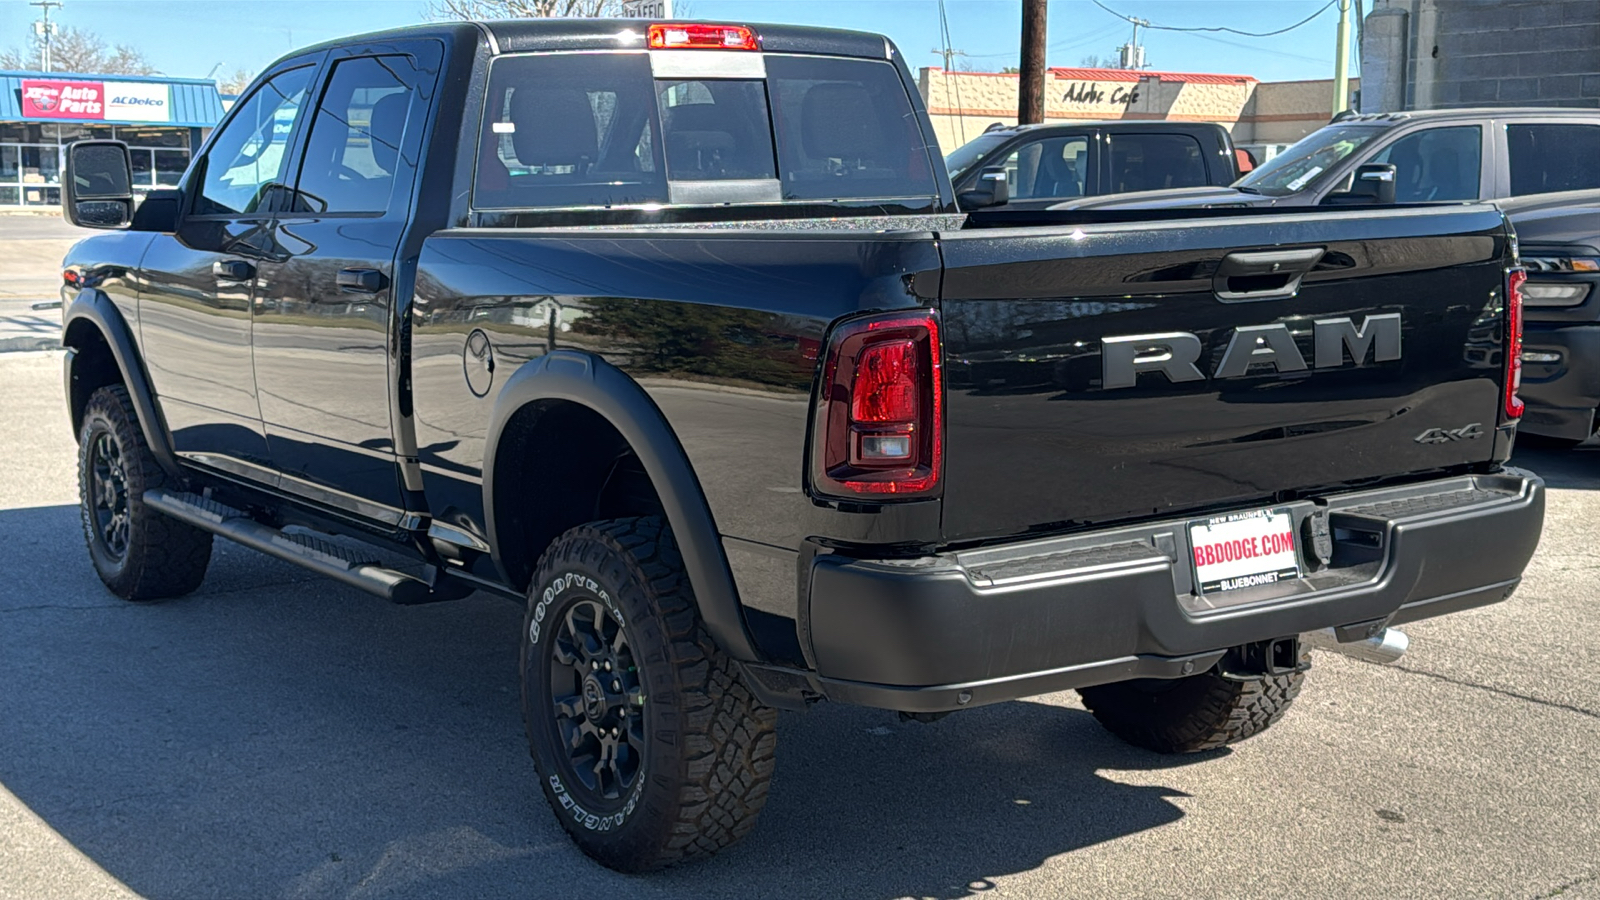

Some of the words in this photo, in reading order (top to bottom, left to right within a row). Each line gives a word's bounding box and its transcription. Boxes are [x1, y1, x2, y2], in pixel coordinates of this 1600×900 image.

[60, 86, 98, 100] Auto
[111, 96, 164, 106] ACDelco
[1062, 82, 1105, 104] Adobe
[1110, 84, 1139, 111] Cafe
[59, 100, 102, 114] Parts
[1101, 312, 1401, 390] RAM
[1209, 516, 1227, 525] NEW
[1193, 531, 1295, 567] BBDODGE.COM
[1220, 571, 1279, 591] BLUEBONNET
